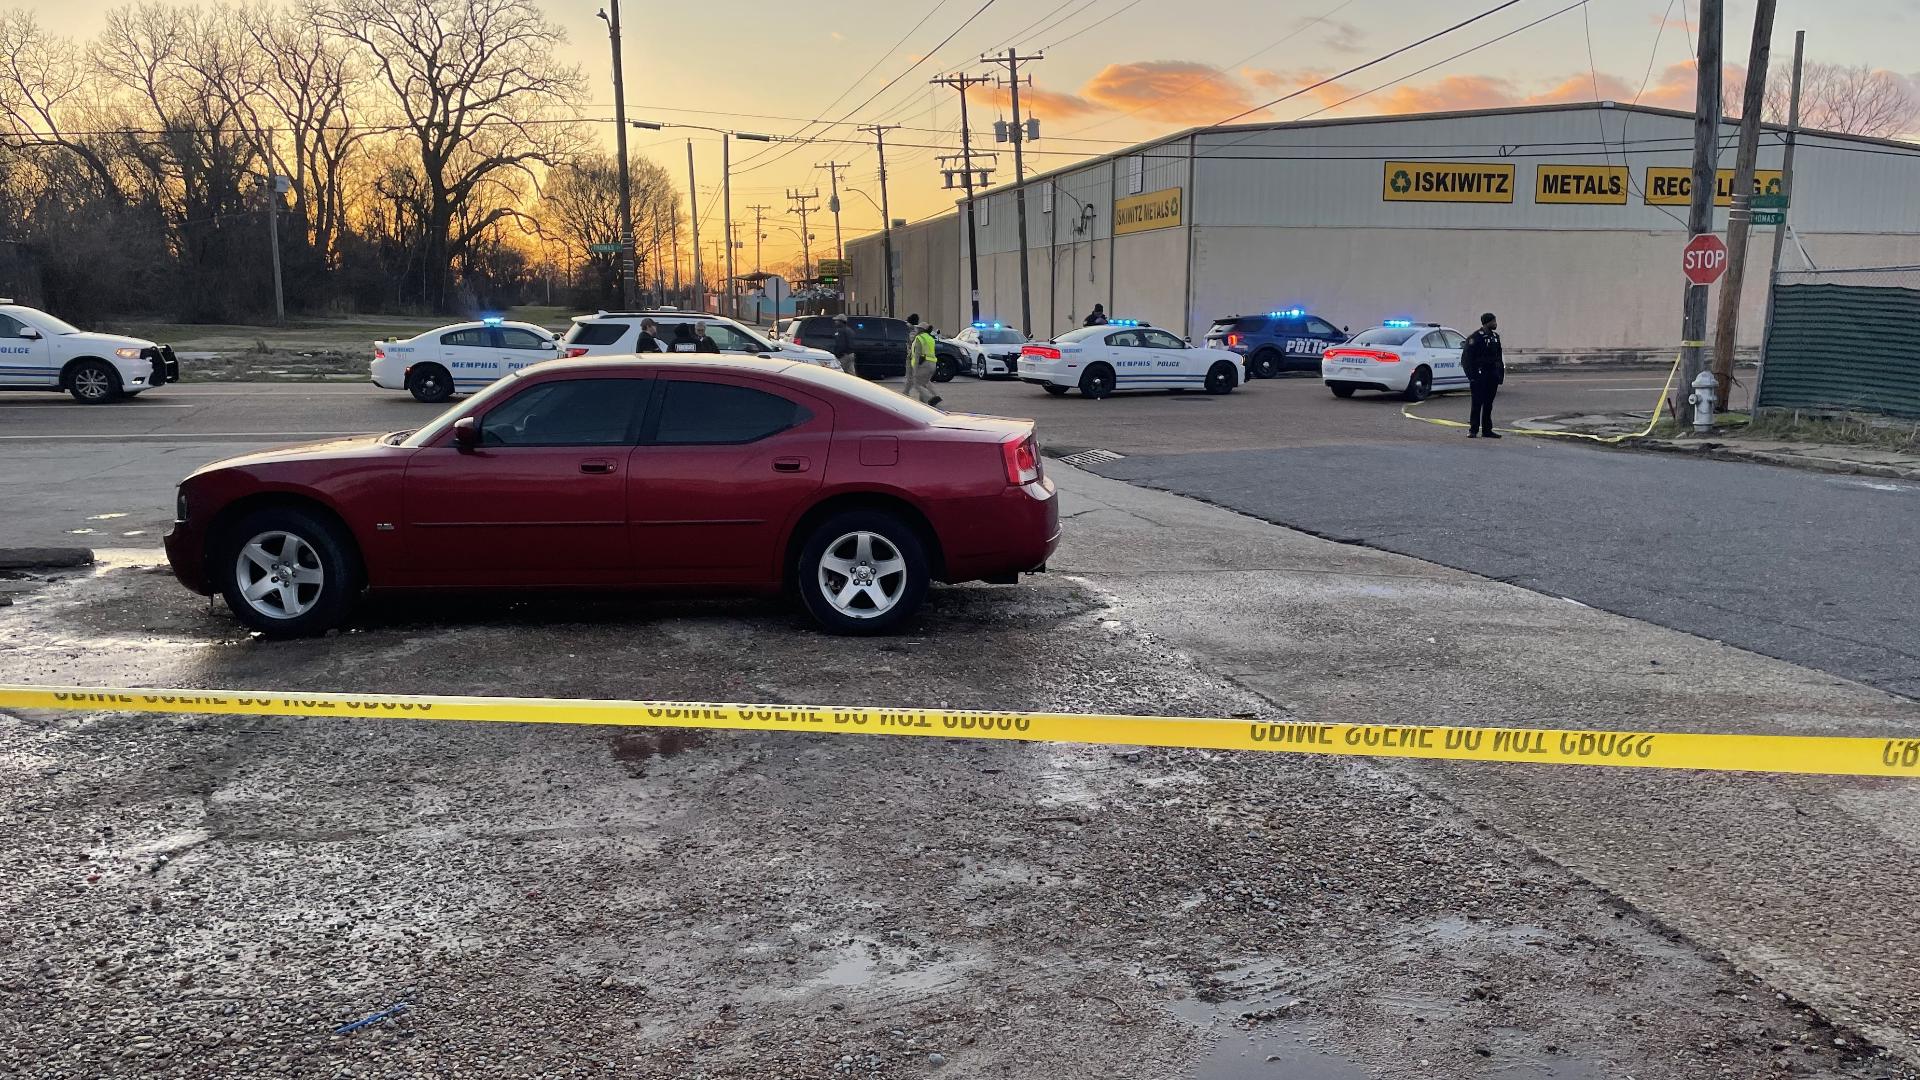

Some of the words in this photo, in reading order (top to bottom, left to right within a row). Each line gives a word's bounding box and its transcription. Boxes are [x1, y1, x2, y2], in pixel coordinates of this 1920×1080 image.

[1415, 171, 1508, 193] ISKIWITZ
[1542, 174, 1621, 195] METALS
[1653, 176, 1761, 197] RECLIG
[1144, 200, 1169, 220] METALS
[1685, 250, 1725, 269] STOP
[0, 346, 31, 354] OLICE
[451, 361, 498, 369] MEMPHIS
